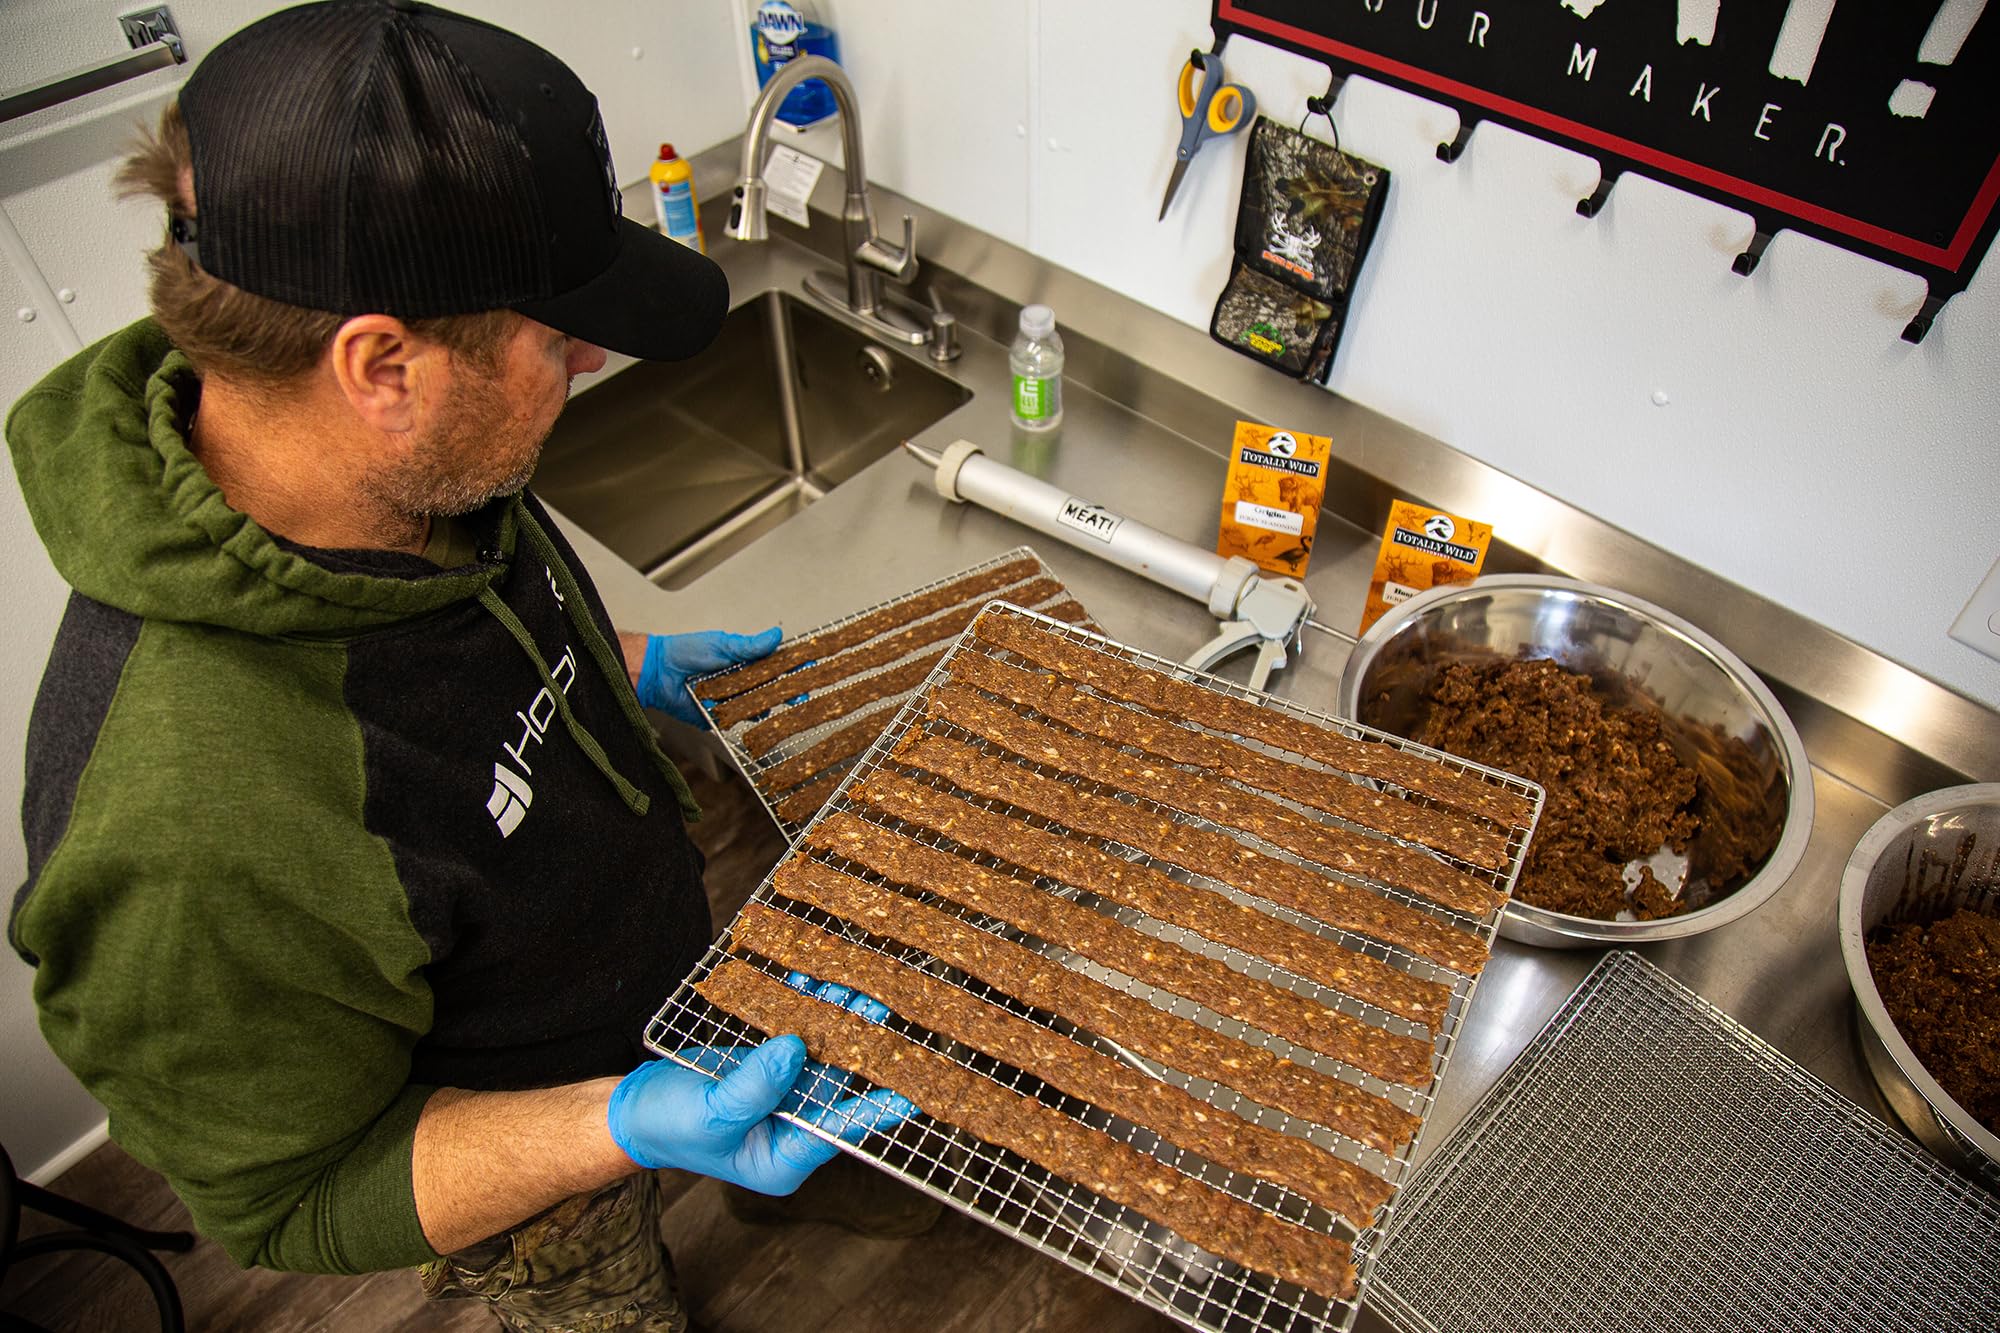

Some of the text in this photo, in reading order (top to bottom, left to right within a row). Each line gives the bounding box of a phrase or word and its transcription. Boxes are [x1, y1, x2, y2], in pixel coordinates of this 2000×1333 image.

[758, 10, 802, 33] DAWN
[1243, 450, 1317, 474] TOTALLY WILD
[1065, 503, 1114, 534] MEAT!
[1396, 530, 1474, 561] TOTALLY WILD
